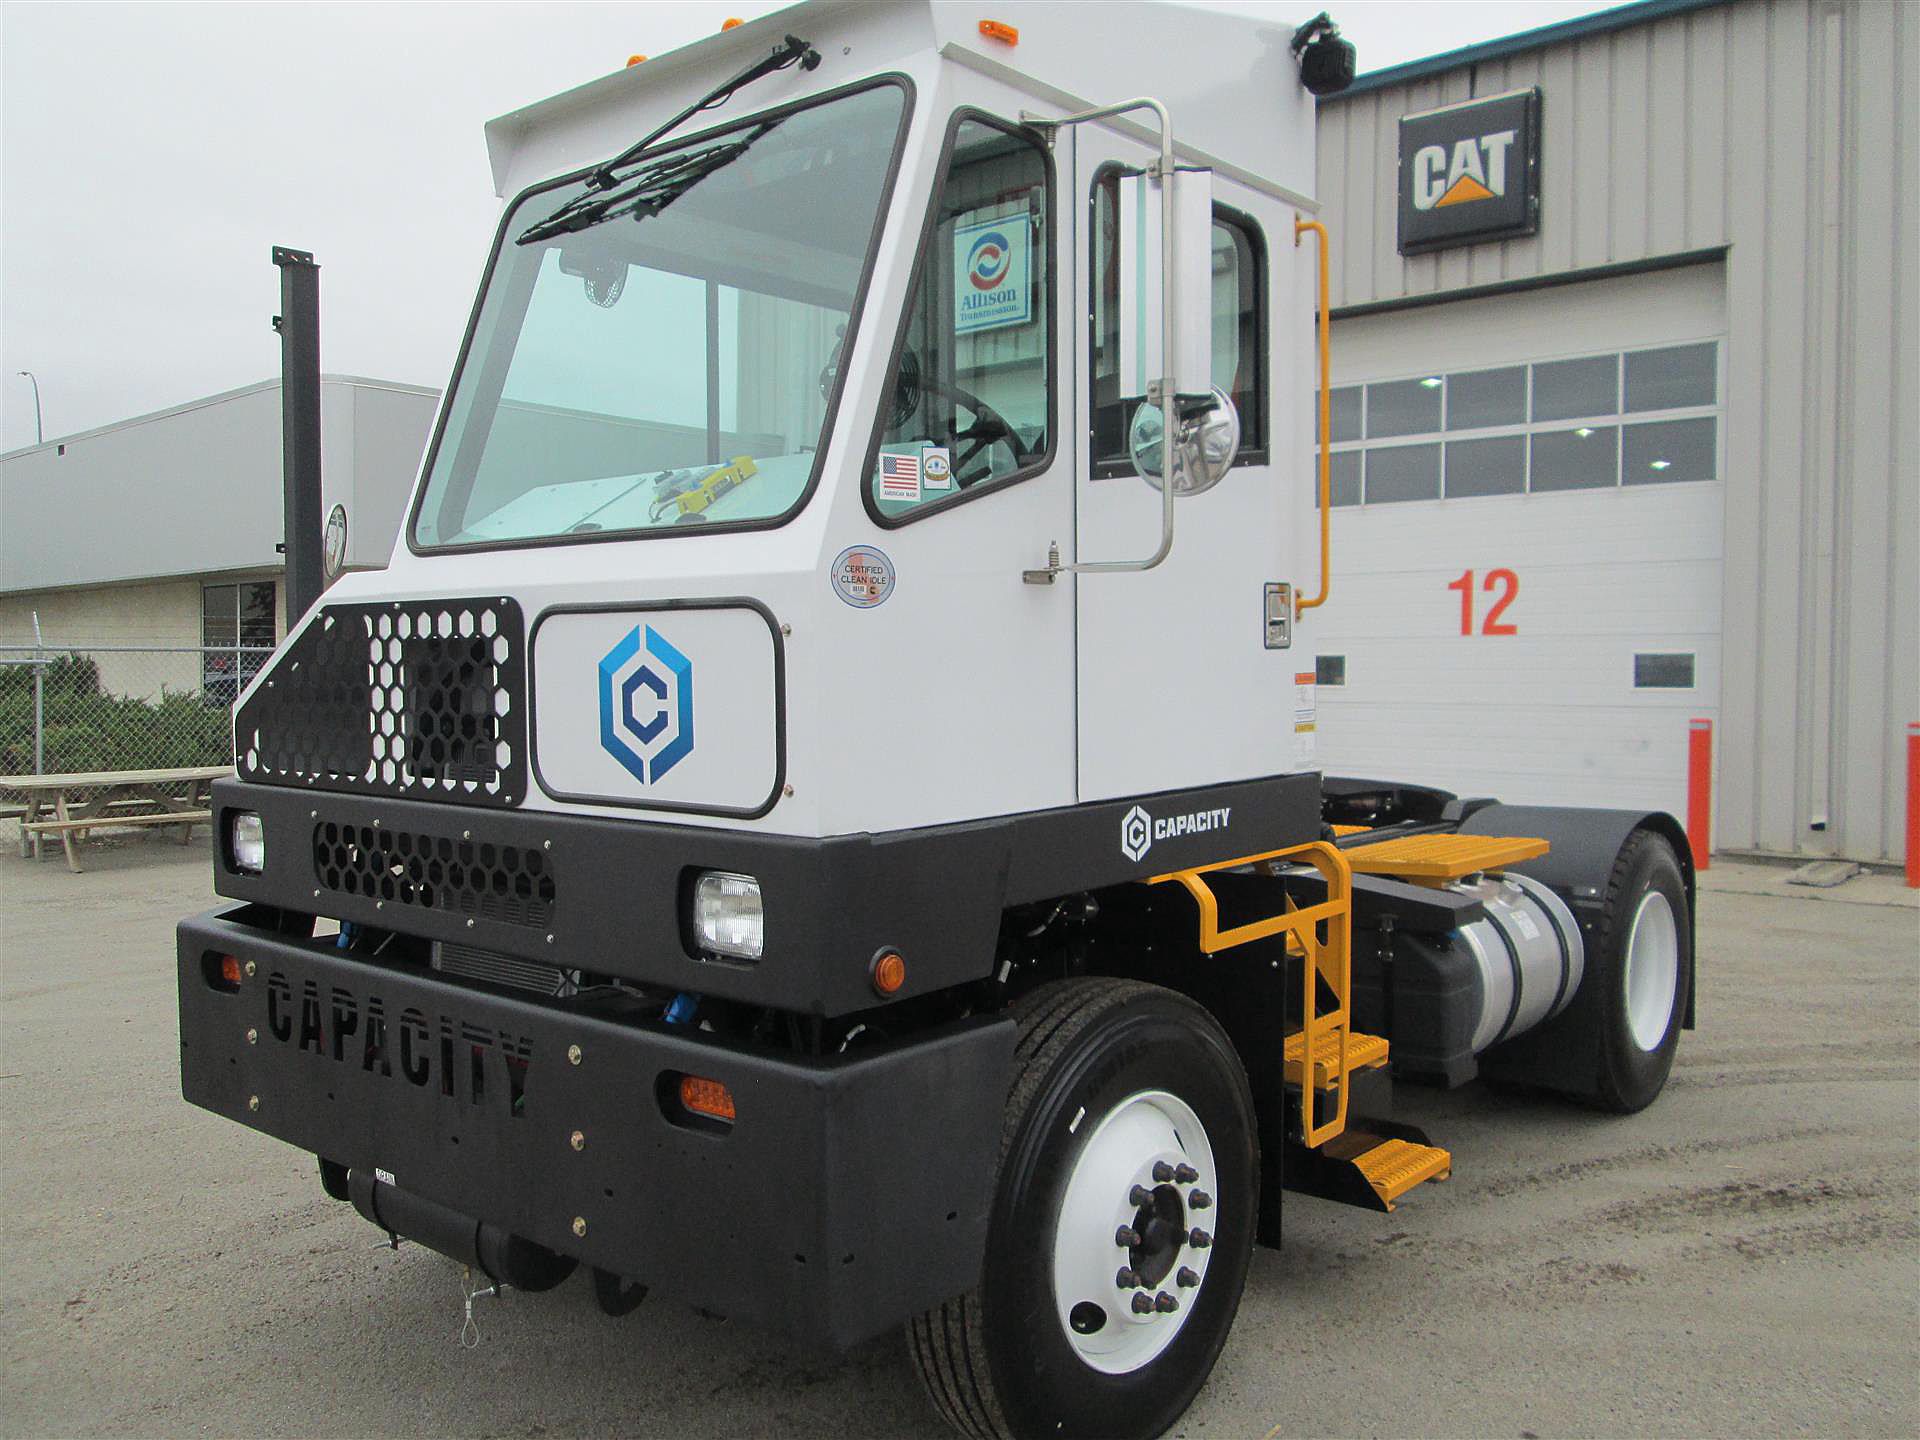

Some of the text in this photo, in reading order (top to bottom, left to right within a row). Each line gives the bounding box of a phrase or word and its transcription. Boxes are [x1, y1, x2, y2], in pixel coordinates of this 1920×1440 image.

[1414, 130, 1514, 211] CAT
[960, 288, 1016, 311] Allison
[840, 575, 867, 584] CLEAN
[844, 564, 884, 574] CERTIFIED
[1448, 568, 1520, 636] 12
[1154, 807, 1231, 840] CAPACITY
[267, 971, 535, 1118] CAPACITY
